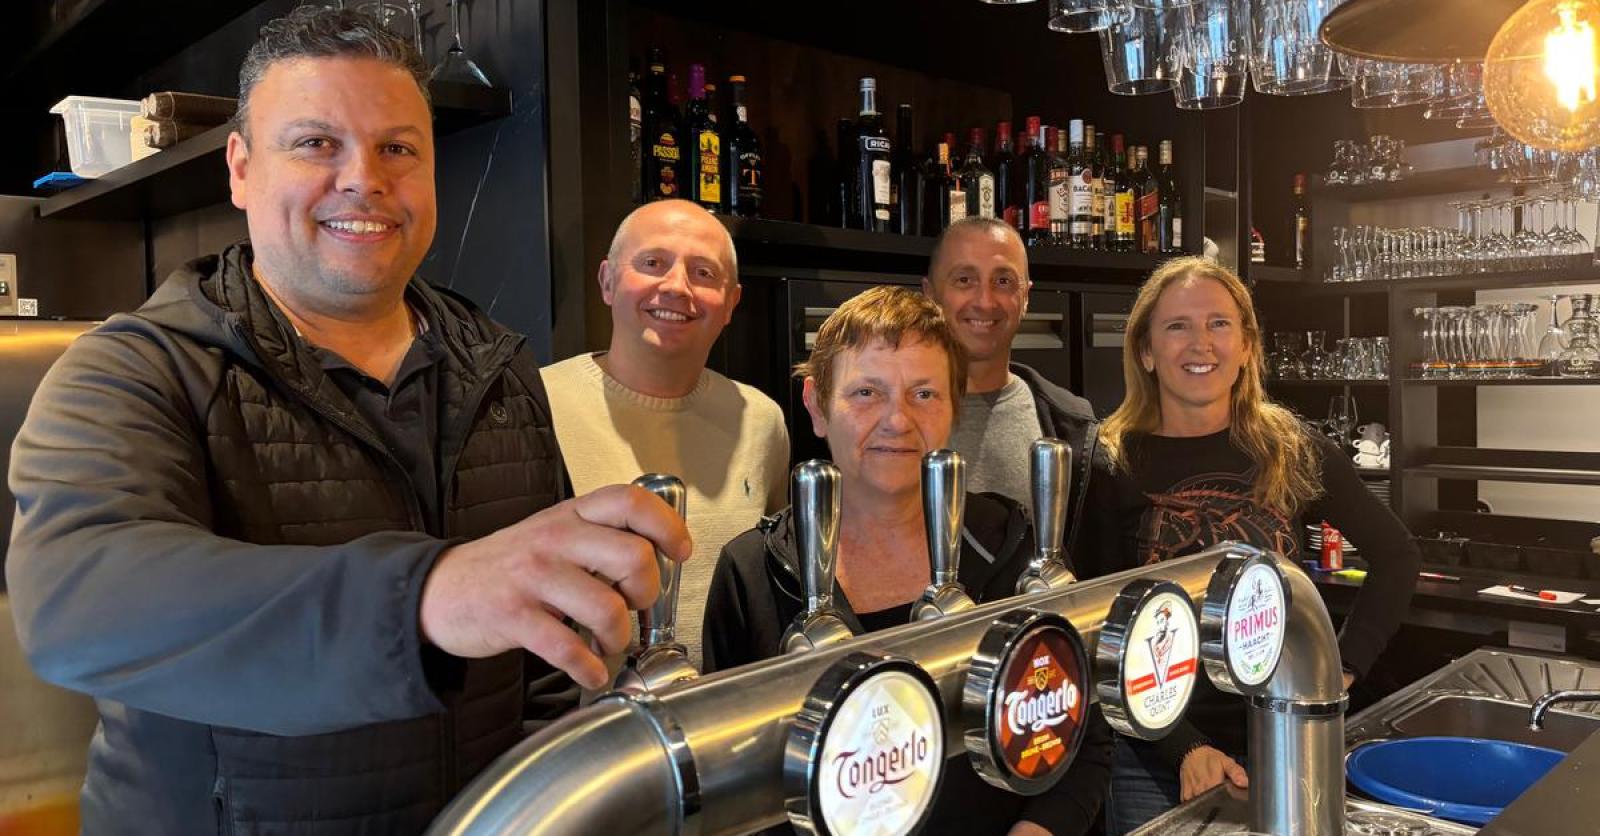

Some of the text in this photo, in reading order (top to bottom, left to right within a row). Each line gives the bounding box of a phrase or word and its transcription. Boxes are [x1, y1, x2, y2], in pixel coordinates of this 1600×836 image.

[1234, 606, 1278, 643] PRIMUS
[872, 704, 889, 718] LUX
[1004, 678, 1078, 736] Tongerlo
[1144, 685, 1177, 708] CHARLES
[832, 730, 928, 799] Tongerlo
